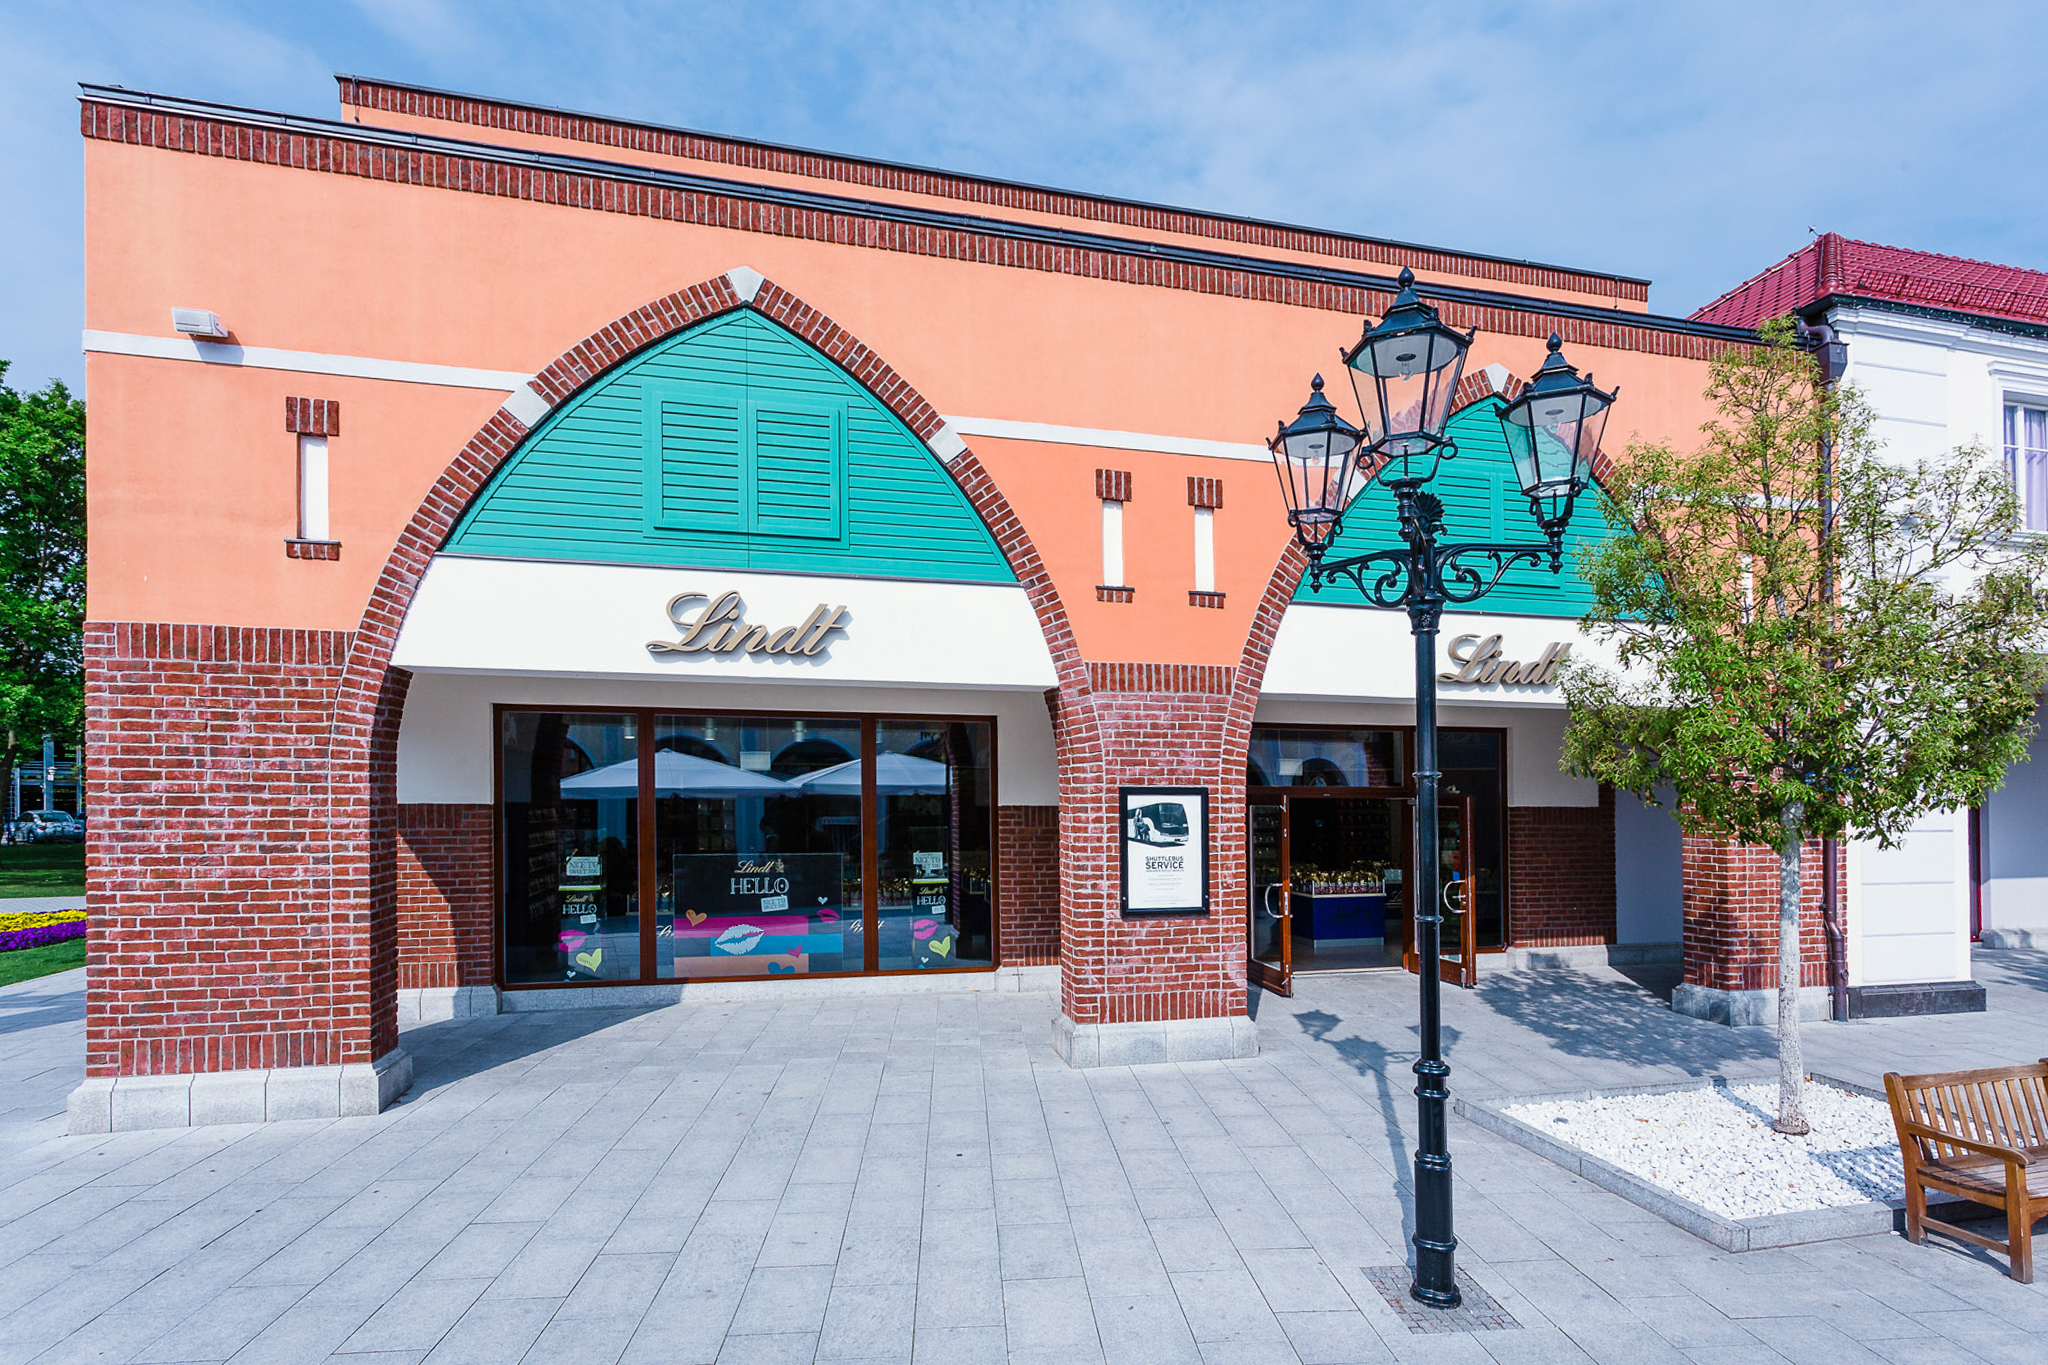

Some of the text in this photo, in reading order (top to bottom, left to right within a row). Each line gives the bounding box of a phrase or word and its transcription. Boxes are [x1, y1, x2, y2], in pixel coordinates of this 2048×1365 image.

[645, 589, 848, 656] Lindt
[1436, 633, 1573, 685] Lindt
[734, 859, 775, 873] Lindt
[730, 877, 790, 894] HELLO
[566, 894, 588, 903] Lindt
[916, 895, 947, 906] HELLO
[562, 904, 597, 914] HELLO
